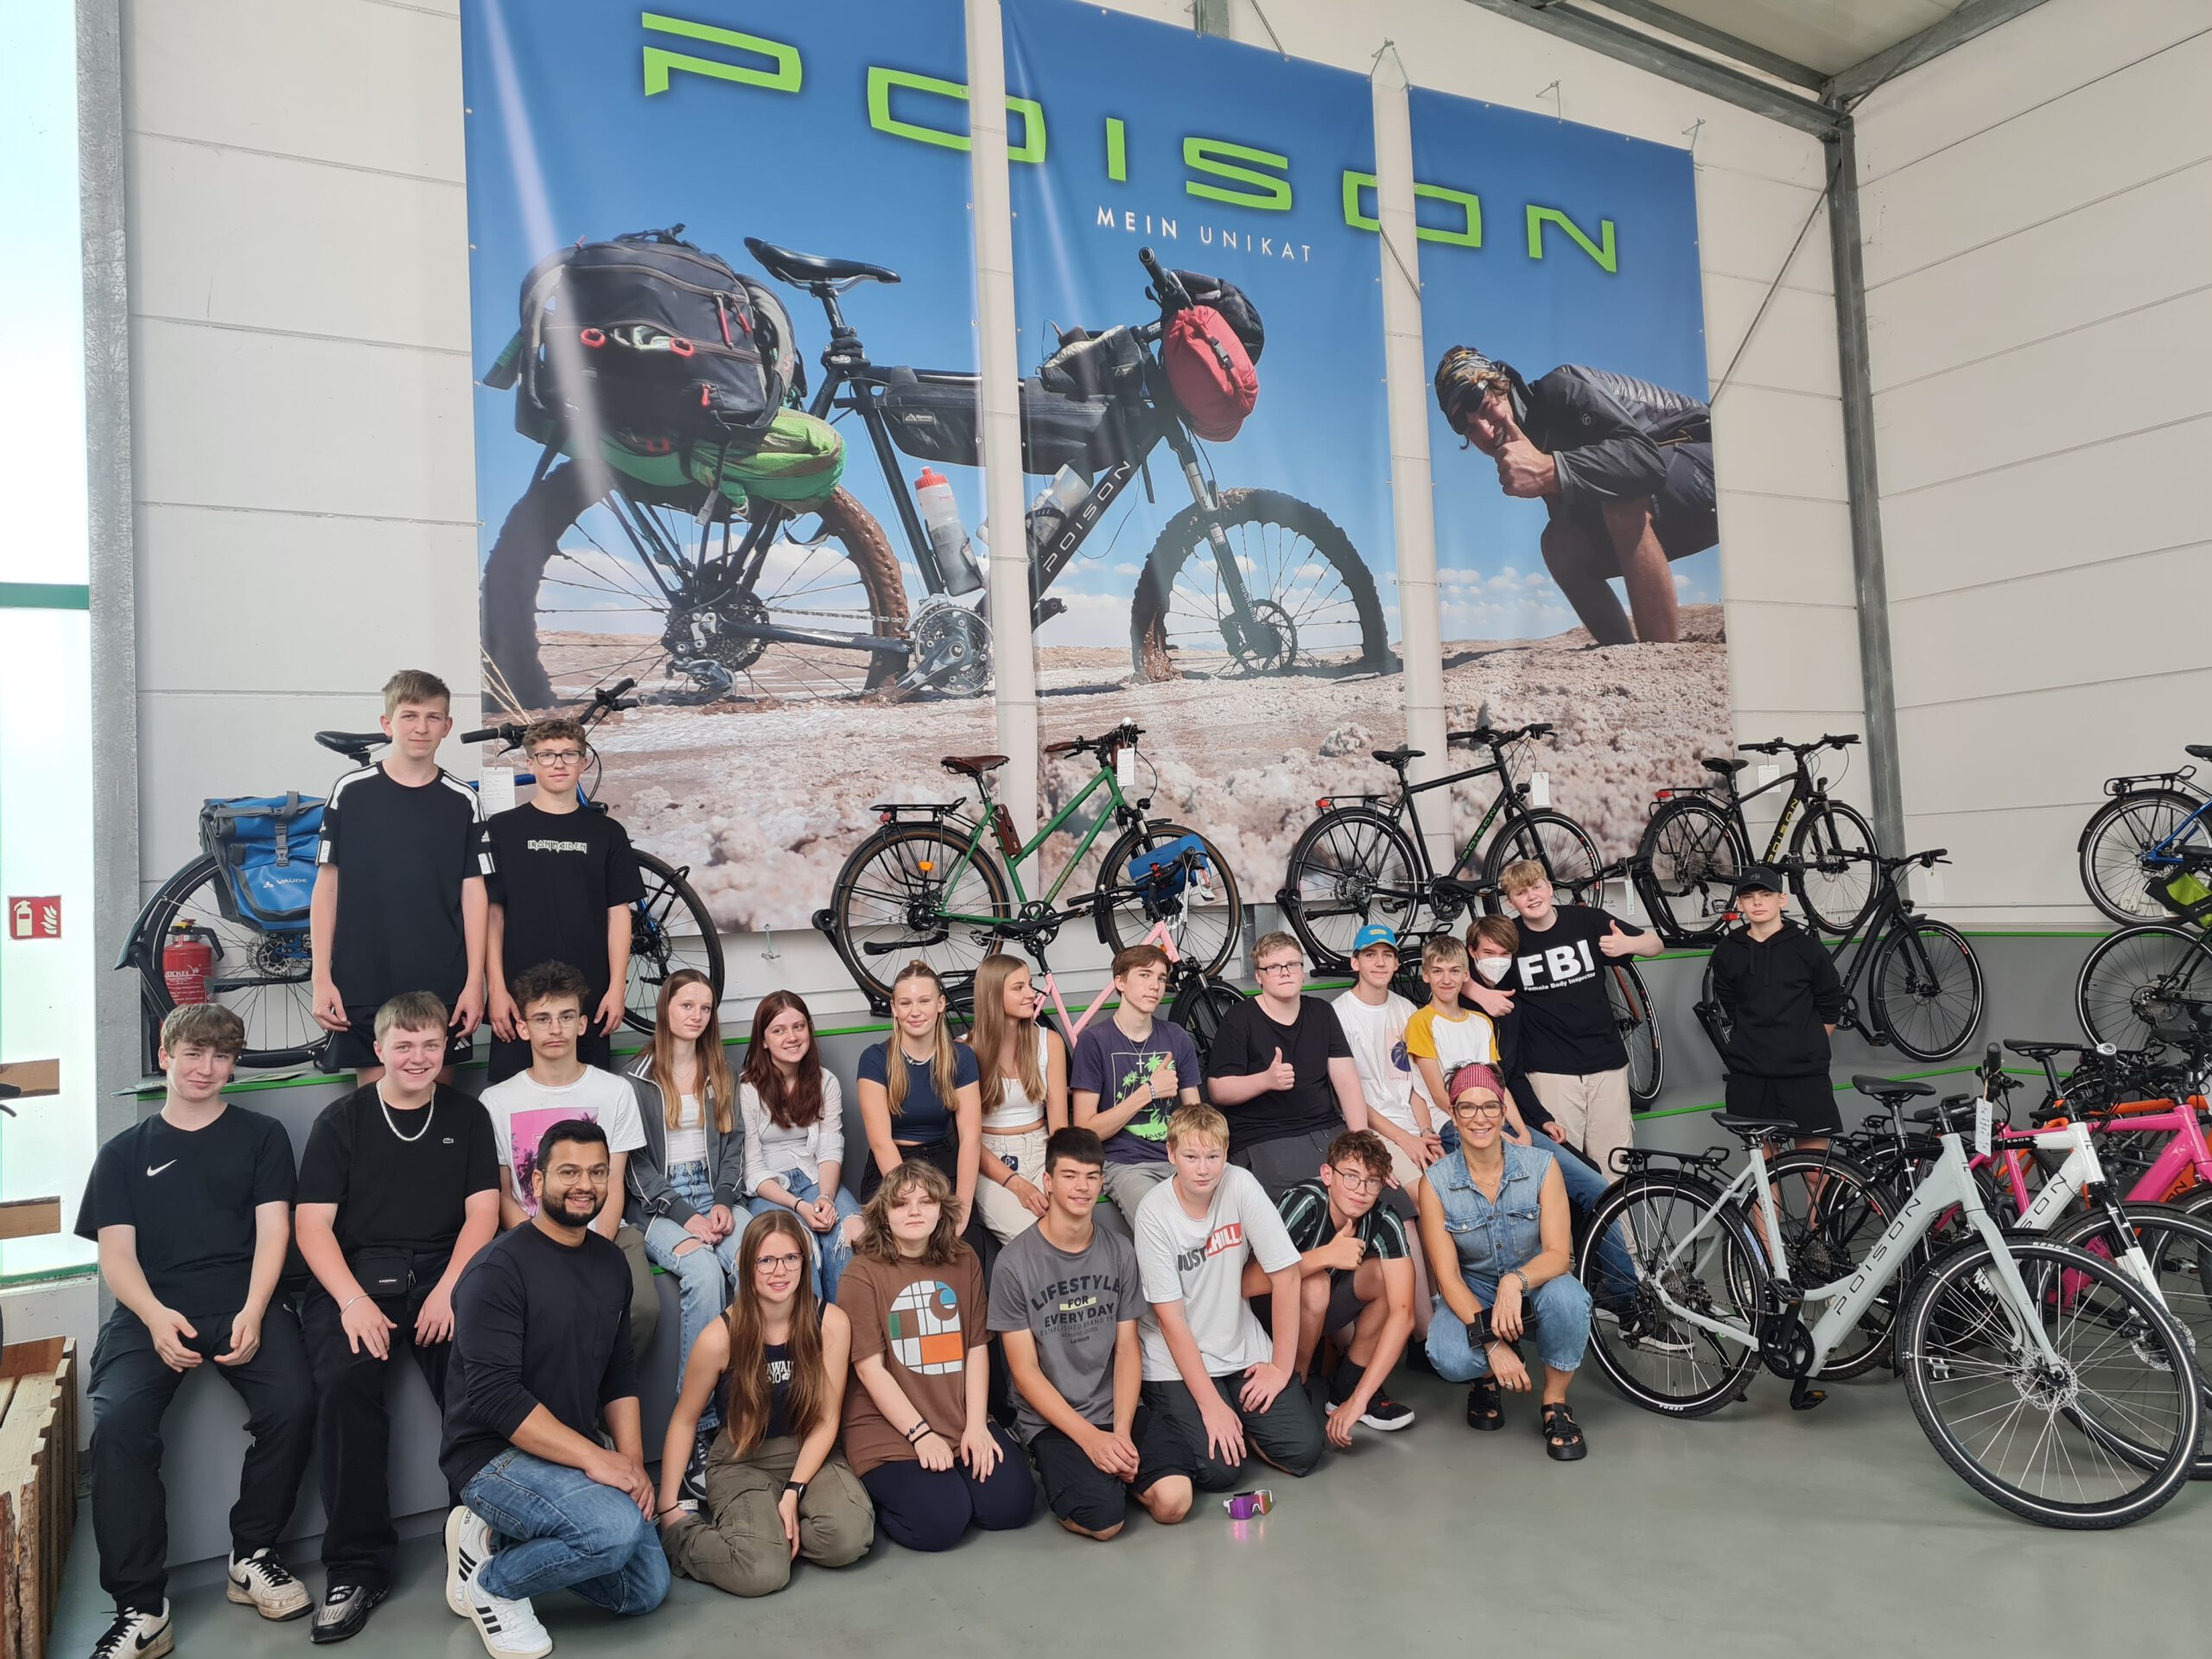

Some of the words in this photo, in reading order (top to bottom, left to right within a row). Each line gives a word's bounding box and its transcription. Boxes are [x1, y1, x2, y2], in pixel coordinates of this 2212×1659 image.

[642, 12, 1618, 273] POISON
[1097, 205, 1177, 239] MEIN
[1200, 225, 1311, 263] UNIKAT
[1042, 460, 1130, 573] POISON
[527, 839, 551, 852] IRON
[552, 841, 588, 855] MAIDEN
[1462, 808, 1497, 859] POISON
[1516, 938, 1595, 987] FBI
[1550, 980, 1567, 989] Body
[1567, 972, 1597, 985] Inspector
[2019, 1172, 2067, 1229] SON
[1177, 1245, 1207, 1272] JUST
[1833, 1198, 1921, 1316] POISON
[2032, 1241, 2069, 1253] KENDA
[1044, 1310, 1084, 1328] EVERY
[1087, 1302, 1115, 1319] DAY
[1067, 1295, 1089, 1308] FOR
[766, 1360, 794, 1376] AWAI
